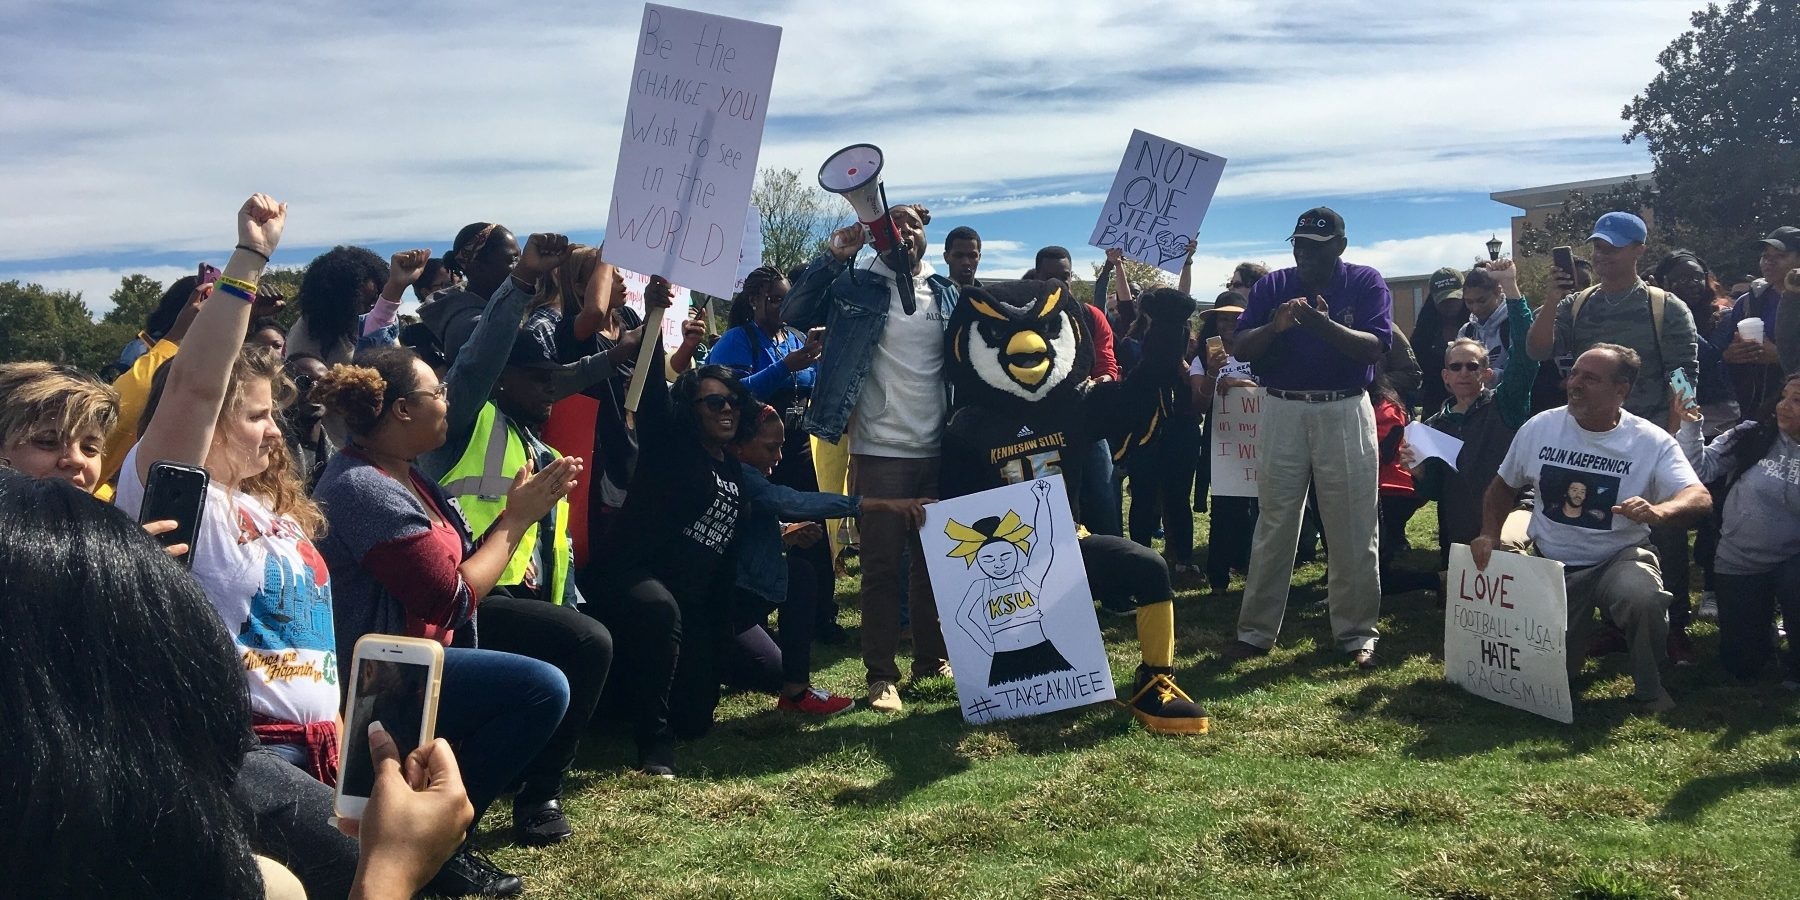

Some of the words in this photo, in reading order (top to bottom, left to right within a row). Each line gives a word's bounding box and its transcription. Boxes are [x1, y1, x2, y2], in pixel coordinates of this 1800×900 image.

[642, 9, 673, 60] Be
[693, 23, 736, 73] the
[636, 68, 708, 106] CHANGE
[717, 86, 758, 121] YOU
[630, 108, 678, 148] Wish
[688, 121, 709, 158] to
[719, 143, 742, 170] see
[1134, 140, 1209, 189] NOT
[642, 166, 663, 192] in
[676, 163, 716, 209] the
[1123, 176, 1187, 220] ONE
[615, 196, 725, 266] WORLD
[1108, 201, 1170, 235] STEP
[1096, 225, 1156, 262] BACK
[1218, 393, 1230, 415] I
[1241, 395, 1264, 414] WI
[1239, 422, 1257, 438] my
[990, 439, 1038, 465] KENNESAW
[1038, 431, 1067, 447] STATE
[1218, 442, 1232, 456] I
[1238, 443, 1256, 459] WI
[1538, 446, 1568, 464] COLIN
[1567, 450, 1633, 475] KAEPERNICK
[714, 510, 726, 521] BY
[721, 502, 733, 514] BY
[693, 521, 707, 534] ON
[707, 528, 722, 543] HER
[712, 520, 728, 534] HER
[988, 591, 1034, 620] KSU
[1460, 569, 1514, 609] LOVE
[1454, 604, 1512, 639] FOOTBALL
[243, 649, 279, 671] Things
[282, 651, 298, 663] are
[1481, 639, 1521, 672] HATE
